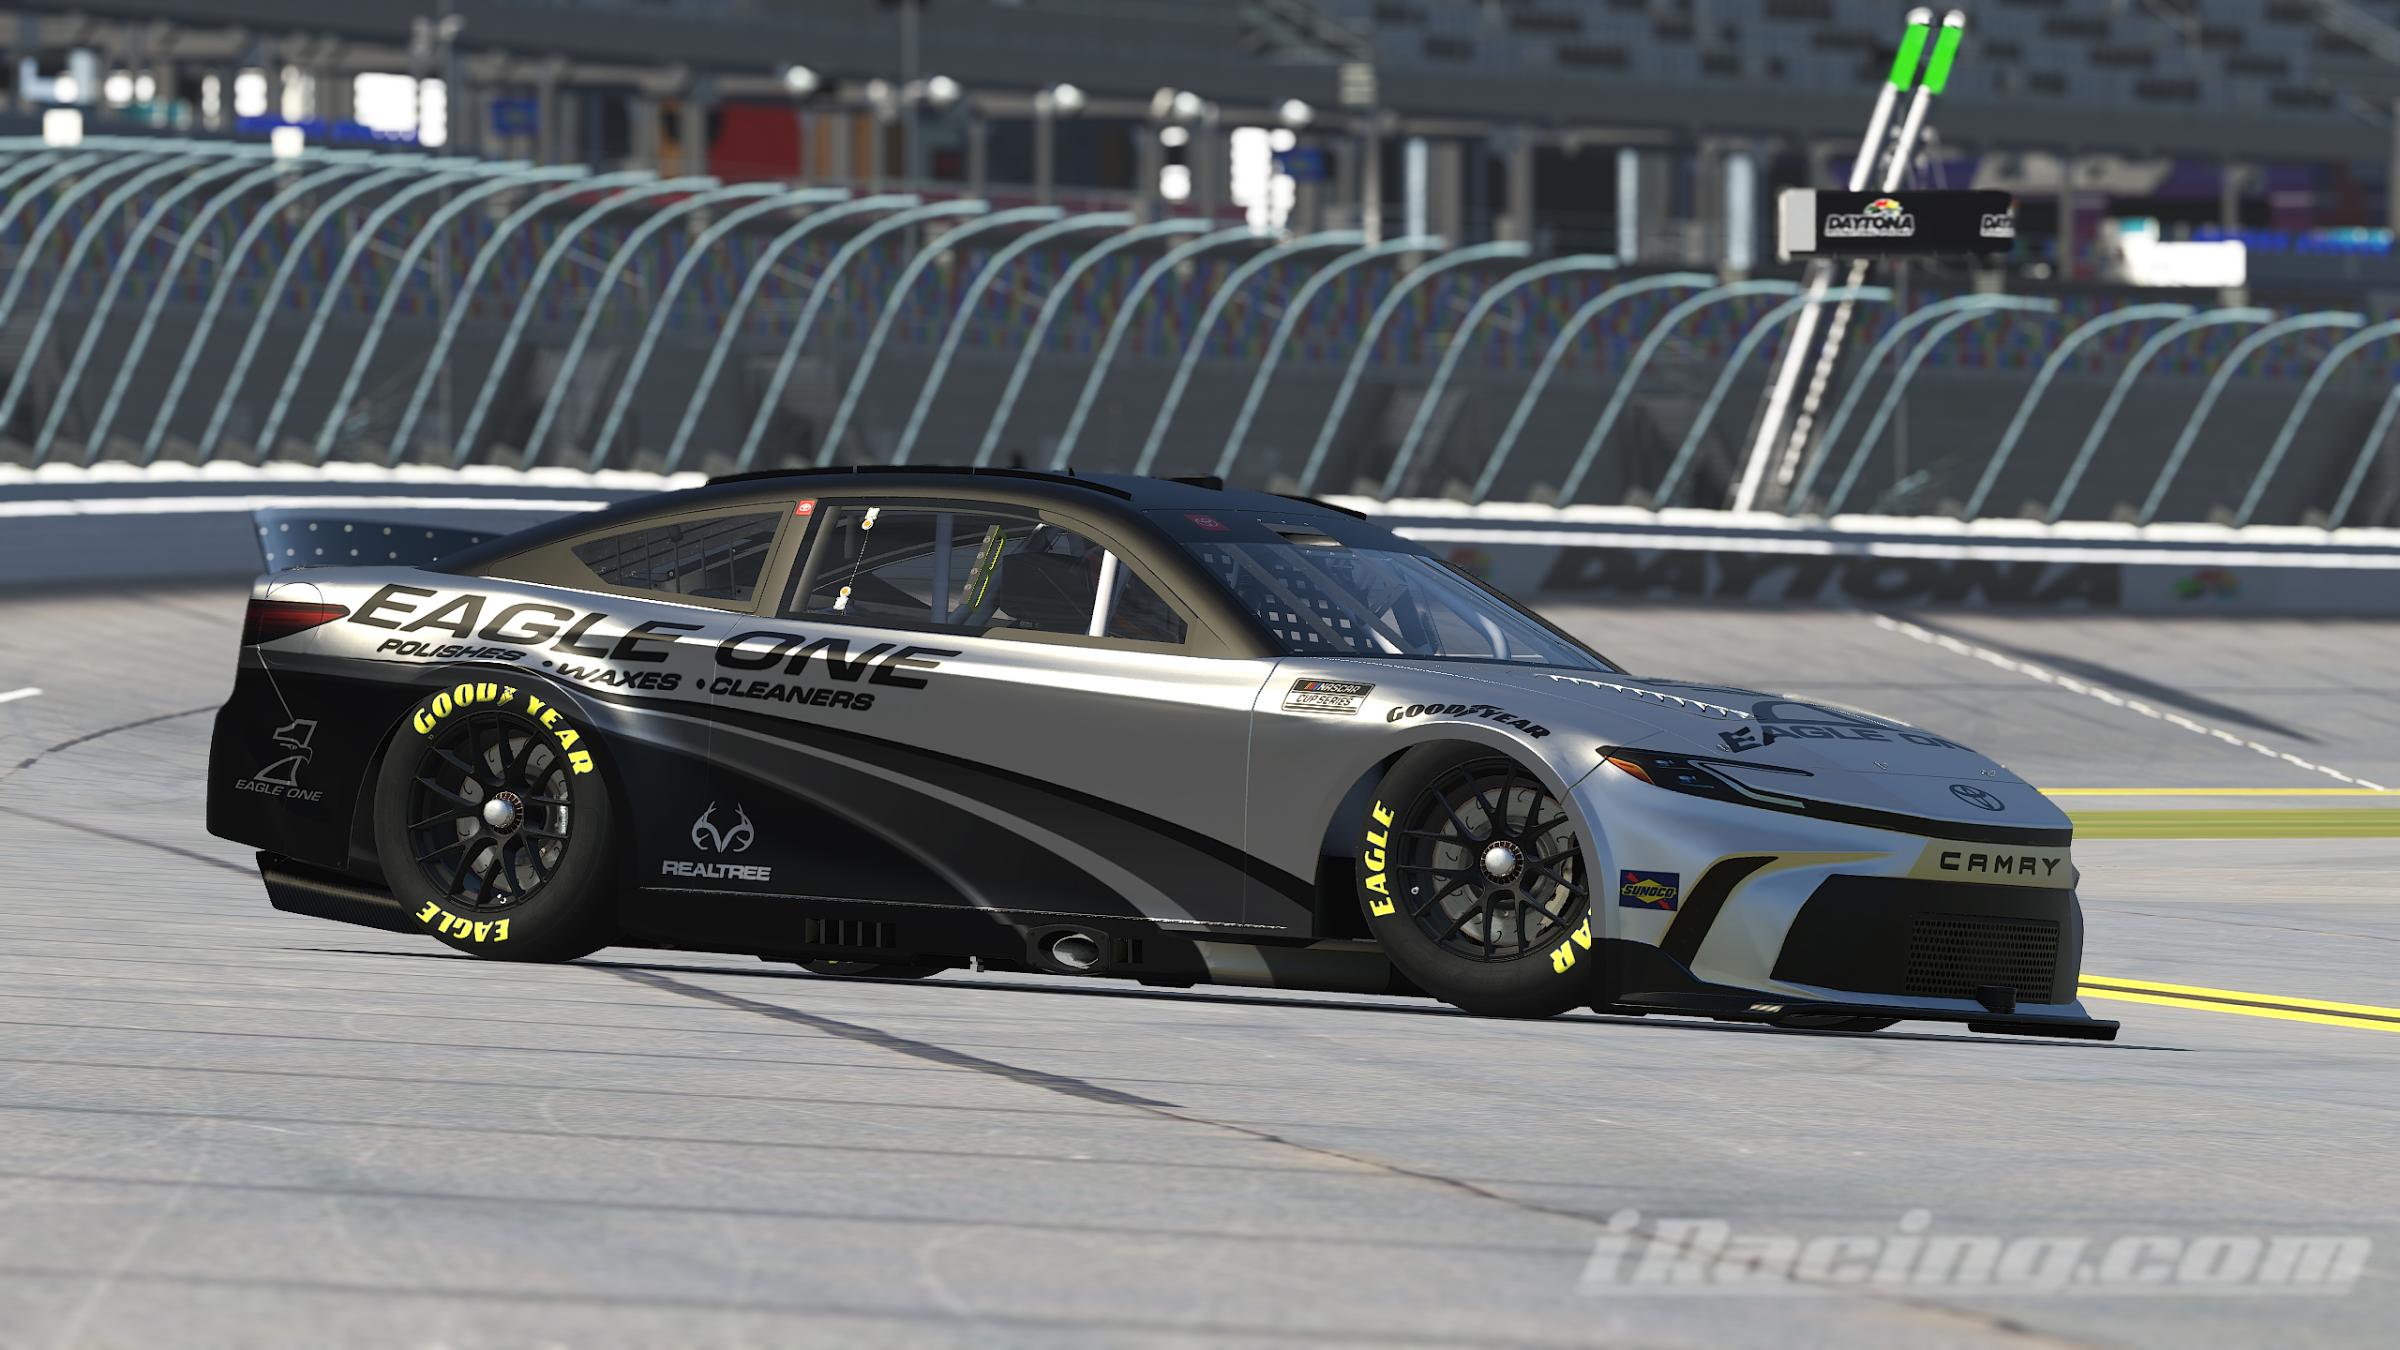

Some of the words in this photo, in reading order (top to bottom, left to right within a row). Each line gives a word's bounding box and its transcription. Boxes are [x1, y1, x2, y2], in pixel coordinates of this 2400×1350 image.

[1826, 214, 1914, 231] DAYTONA
[1539, 546, 2122, 606] DAYTONA
[347, 583, 705, 663] EAGLE
[715, 630, 963, 690] ONE
[376, 638, 527, 661] POLISHES
[556, 663, 682, 690] WAXES
[709, 676, 876, 712] CLEANERS
[1317, 682, 1361, 694] NASCAR
[1296, 694, 1319, 703] CUP
[1316, 696, 1354, 706] SERIES
[1386, 703, 1550, 739] GOODYEAR
[1718, 726, 1893, 754] EAGLE
[235, 779, 284, 796] EAGLE
[286, 787, 323, 801] ONE
[662, 860, 771, 881] REALTREE
[1364, 800, 1396, 918] EAGLE
[1939, 851, 2061, 876] CAMRY
[1622, 884, 1677, 898] SUNOCO
[415, 900, 510, 943] EAGLE
